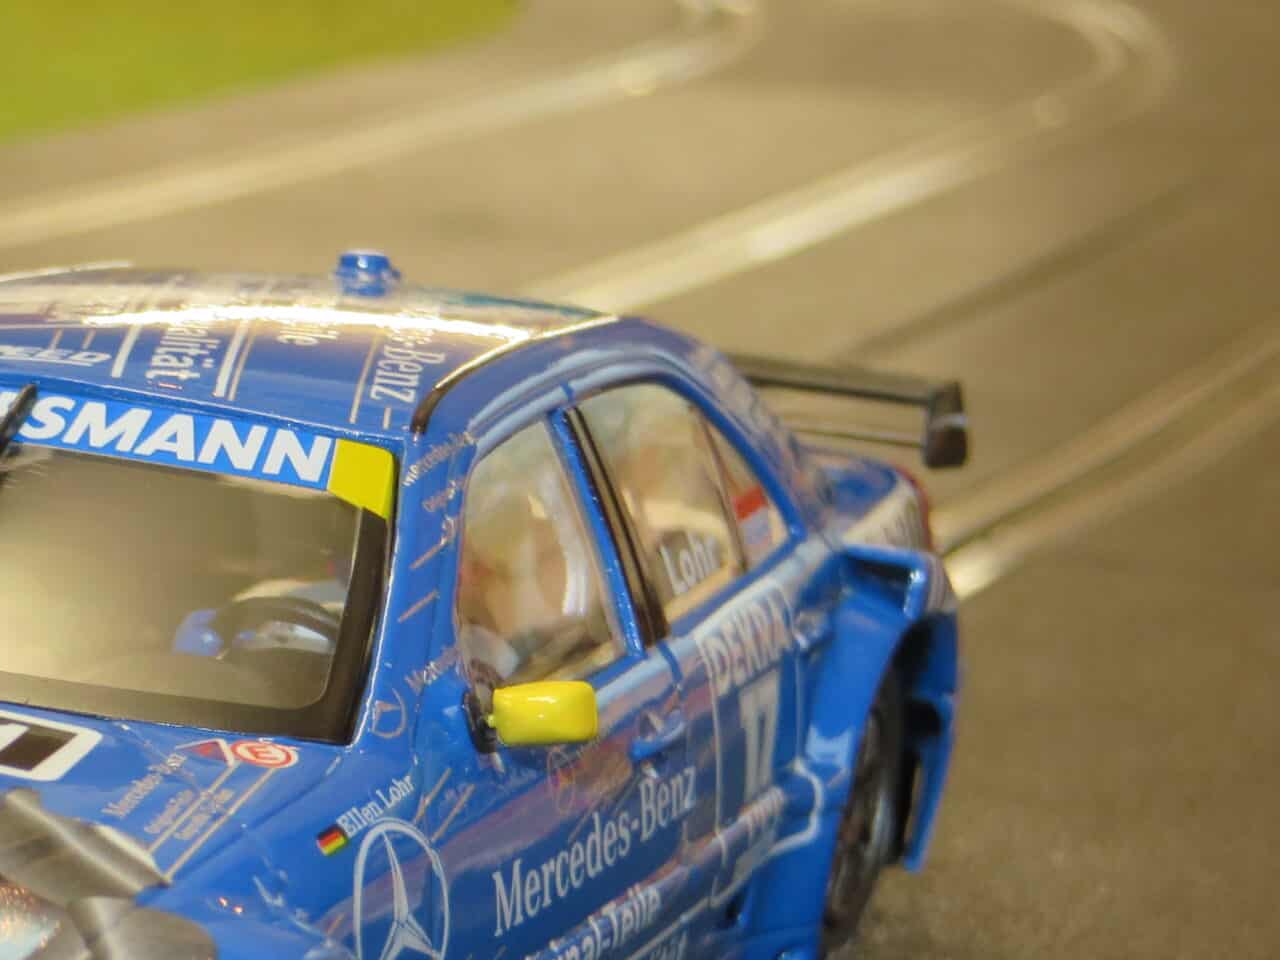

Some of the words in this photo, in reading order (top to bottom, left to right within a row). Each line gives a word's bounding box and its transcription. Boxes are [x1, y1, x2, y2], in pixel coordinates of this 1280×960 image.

[660, 532, 716, 596] Lohr
[336, 801, 384, 838] Ellen
[376, 776, 414, 808] Lohr
[492, 766, 696, 937] Mercedes-Benz
